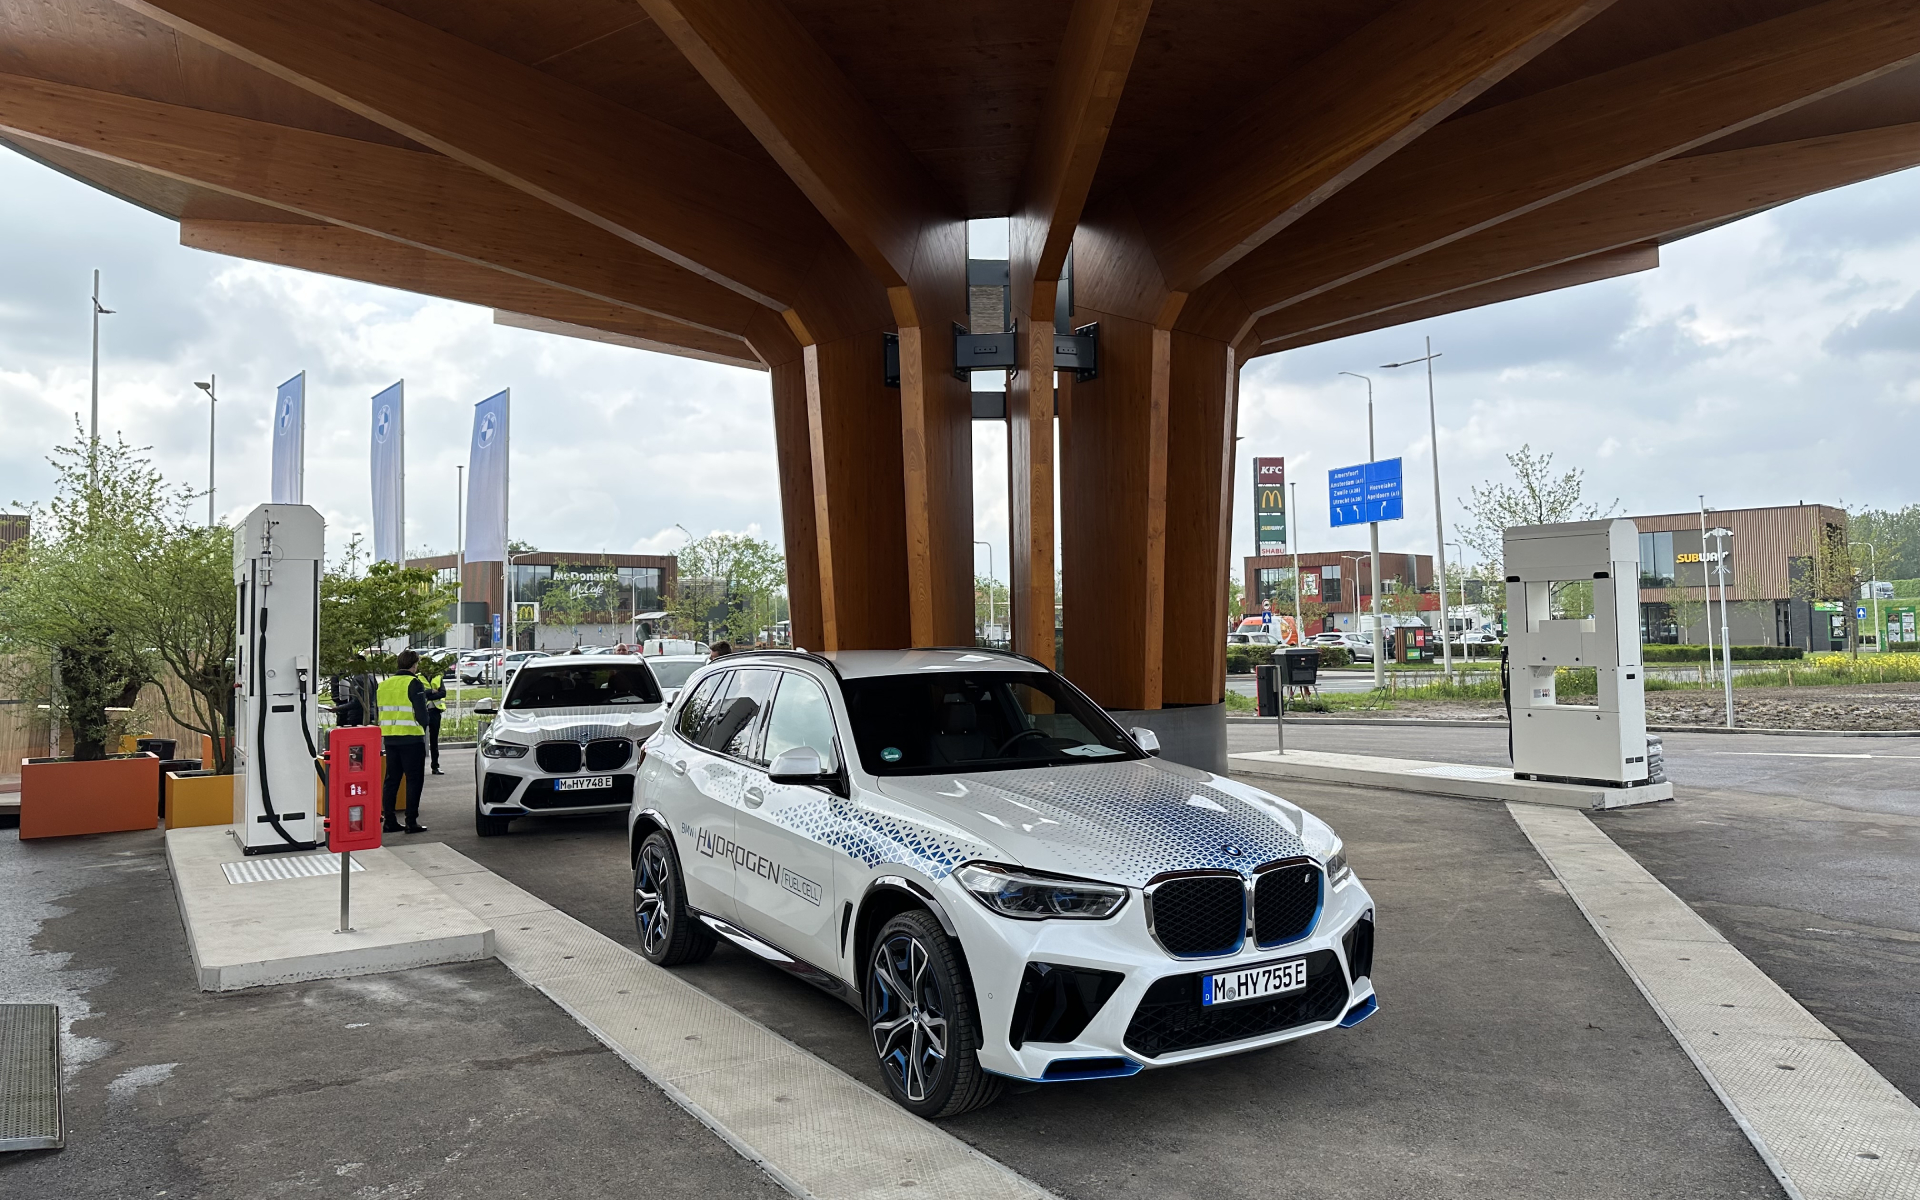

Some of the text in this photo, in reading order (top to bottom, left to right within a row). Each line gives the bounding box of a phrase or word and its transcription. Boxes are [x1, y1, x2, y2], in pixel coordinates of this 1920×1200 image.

[1260, 466, 1282, 474] KFC
[1334, 470, 1358, 479] Amersfoort
[1330, 480, 1354, 488] Amsterdam
[1367, 492, 1390, 500] Apeldoorn
[553, 572, 618, 581] McDonald's
[682, 822, 694, 838] BMW
[696, 826, 780, 884] HYDROGEN
[784, 873, 801, 892] FUEL
[802, 882, 818, 901] CELL
